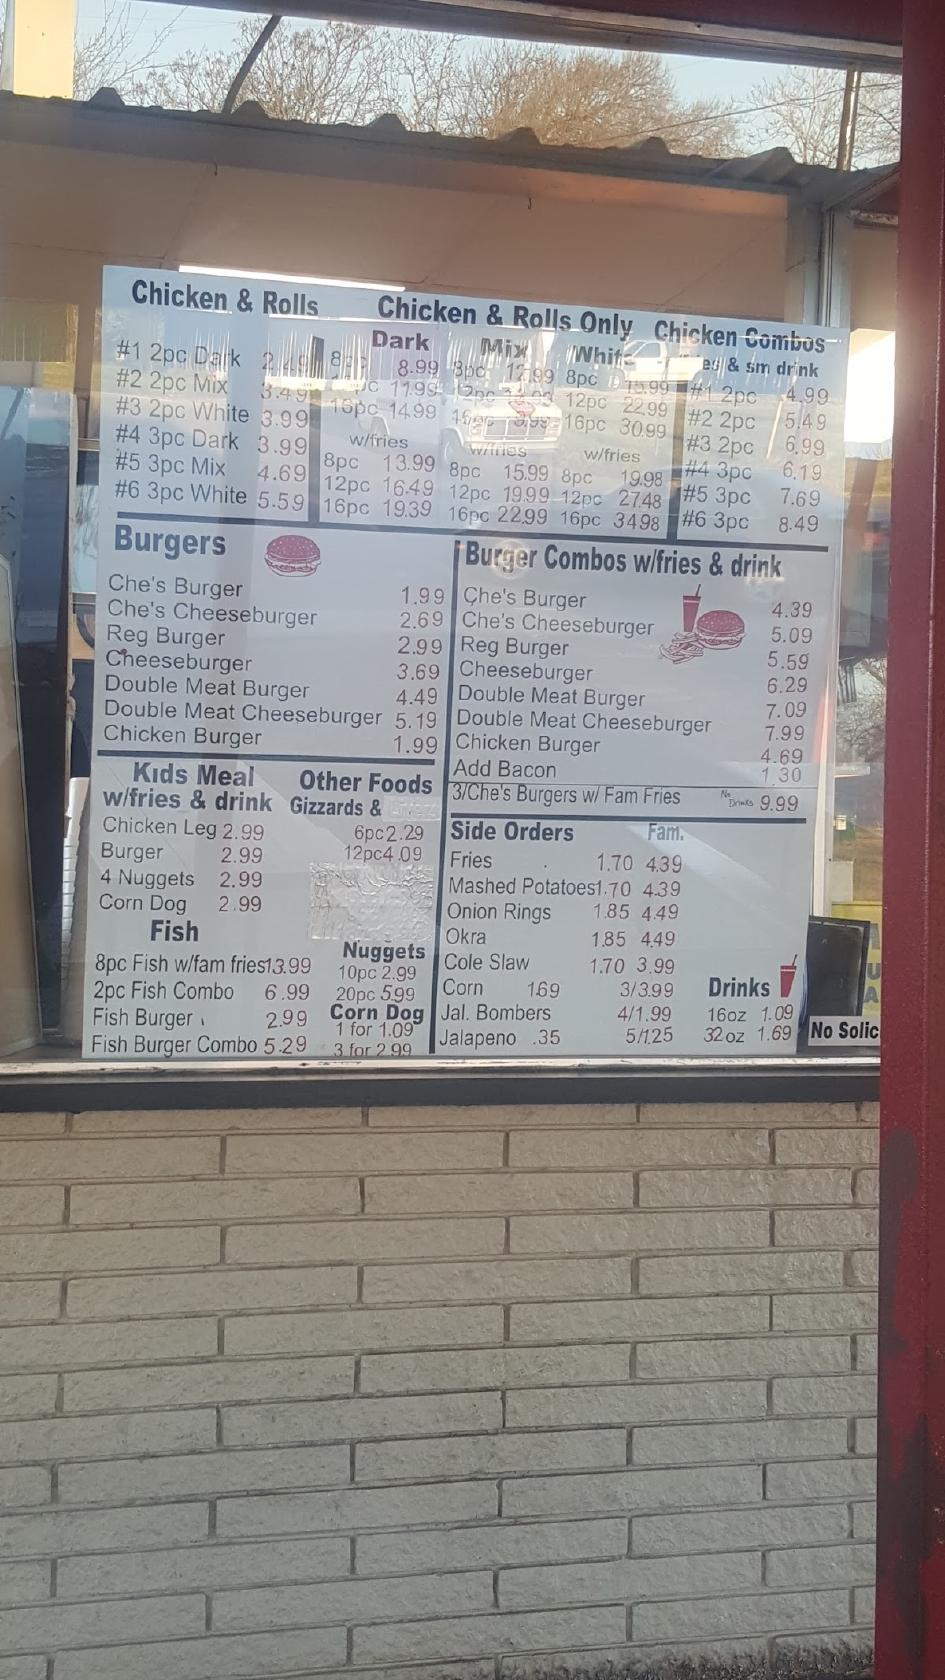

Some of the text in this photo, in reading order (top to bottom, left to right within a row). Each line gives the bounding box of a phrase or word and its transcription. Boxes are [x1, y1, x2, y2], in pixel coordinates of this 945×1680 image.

[132, 279, 319, 316] Chicken & Rolls
[378, 294, 633, 341] Chicken & Rolls Only
[371, 330, 430, 351] Dark
[654, 318, 826, 354] Chicken Combos
[115, 423, 308, 456] #4 3pc Dark 3.99
[349, 432, 409, 450] w/fries
[115, 451, 306, 482] #5 3pc Mix 4.69
[323, 452, 436, 474] 8pc 13.99
[685, 460, 822, 485] #4 3pc 6.19
[115, 479, 305, 512] #6 3pc White 5.59
[324, 475, 434, 498] 12pc 16.49
[323, 498, 370, 520] 16pc
[683, 486, 821, 511] #5 3pc 7.69
[682, 511, 819, 535] #6 3pc 8.49
[115, 524, 226, 560] Burgers
[465, 540, 782, 577] Burger Combos w/fries & drink
[108, 573, 445, 605] Che's Burger 1.99
[108, 598, 444, 630] Che's Cheeseburger 2.69
[107, 624, 443, 655] Reg Burger 2.99
[106, 649, 440, 681] Cheeseburger 3.69
[105, 674, 438, 706] Double Meat Burger 4.49
[104, 699, 437, 729] Double Meat Cheeseburger 5.19
[457, 709, 805, 742] Double Meat Cheeseburger 7.99
[104, 724, 438, 754] Chicken Burger 1.99
[456, 732, 803, 765] Chicken Burger 4.69
[133, 761, 255, 787] Kids Meal
[300, 769, 433, 795] Other Foods
[453, 758, 802, 786] Add Bacon 1.30
[103, 786, 273, 812] w/fries & drink
[290, 796, 382, 816] Gizzards &
[452, 782, 681, 808] 3/Che's Burgers w/ Fam Fries
[759, 794, 799, 812] 9.99
[103, 816, 264, 841] Chicken Leg 2.99
[450, 820, 574, 841] Side Orders
[648, 823, 684, 841] Fam.
[101, 841, 263, 864] Burger 2.99
[450, 851, 682, 873] Fries 1.70 4.39
[100, 868, 262, 890] 4 Nuggets 2.99
[99, 893, 262, 915] Corn Dog 2.99
[447, 902, 679, 925] Onion Rings 1.85 4.49
[151, 919, 199, 942] Fish
[446, 928, 675, 948] Okra 1.85 4.49
[343, 941, 426, 963] Nuggets
[339, 965, 416, 983] 10pc 2.99
[444, 953, 675, 975] Cole Slaw 1.70 3.99
[94, 980, 310, 1003] 2pc Fish Combo 6.99
[336, 984, 415, 1004] 20pc 5.99
[708, 976, 770, 998] Drinks
[93, 1007, 307, 1031] Fish Burger 2.99
[330, 1003, 425, 1025] Corn Dog
[440, 1003, 672, 1022] Jal. Bombers 4/1.99
[708, 1004, 794, 1022] 16oz 1.09
[704, 1025, 792, 1043] 32oz 1.69
[811, 1021, 879, 1039] No Solic
[92, 1035, 307, 1058] Fish Burger Combo 5.29
